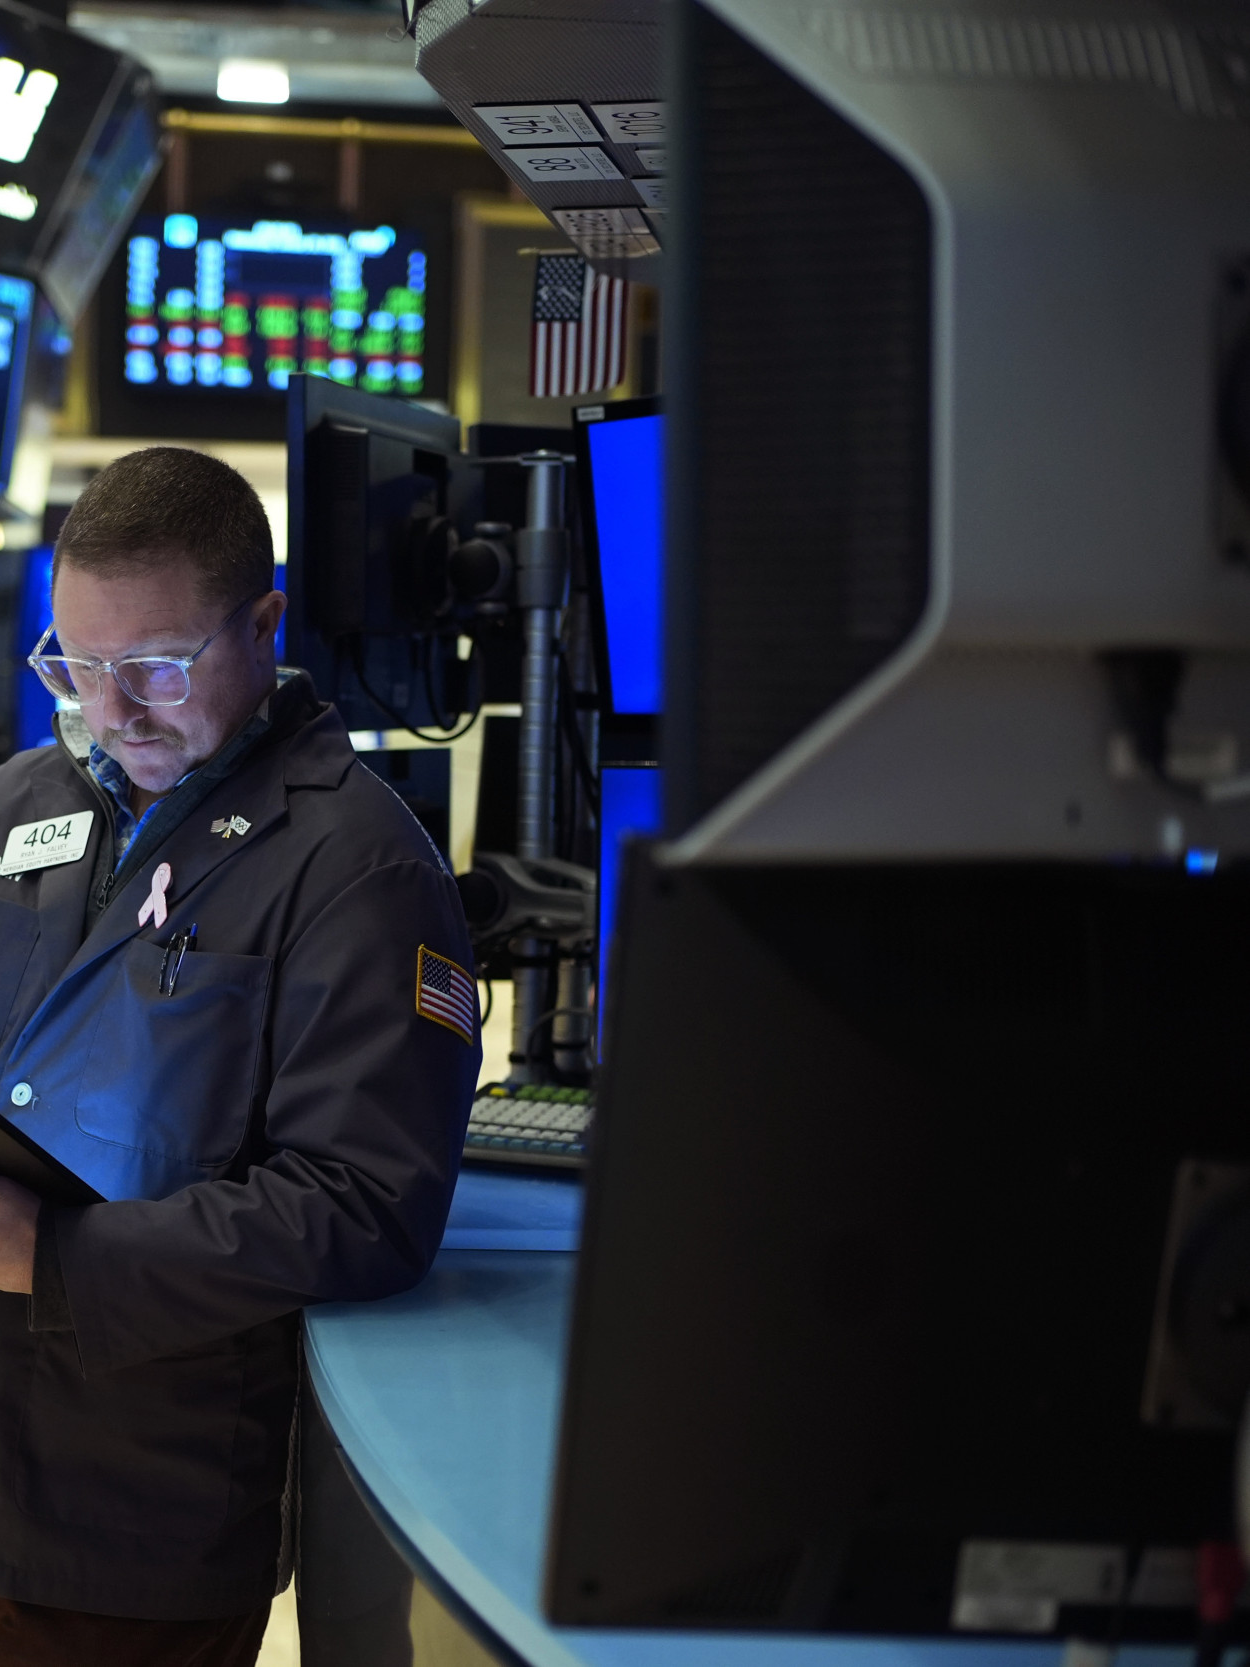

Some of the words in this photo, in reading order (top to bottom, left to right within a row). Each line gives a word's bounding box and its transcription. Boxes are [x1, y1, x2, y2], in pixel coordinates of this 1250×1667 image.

[495, 115, 554, 135] 941
[527, 157, 577, 172] 88
[23, 820, 72, 847] 404
